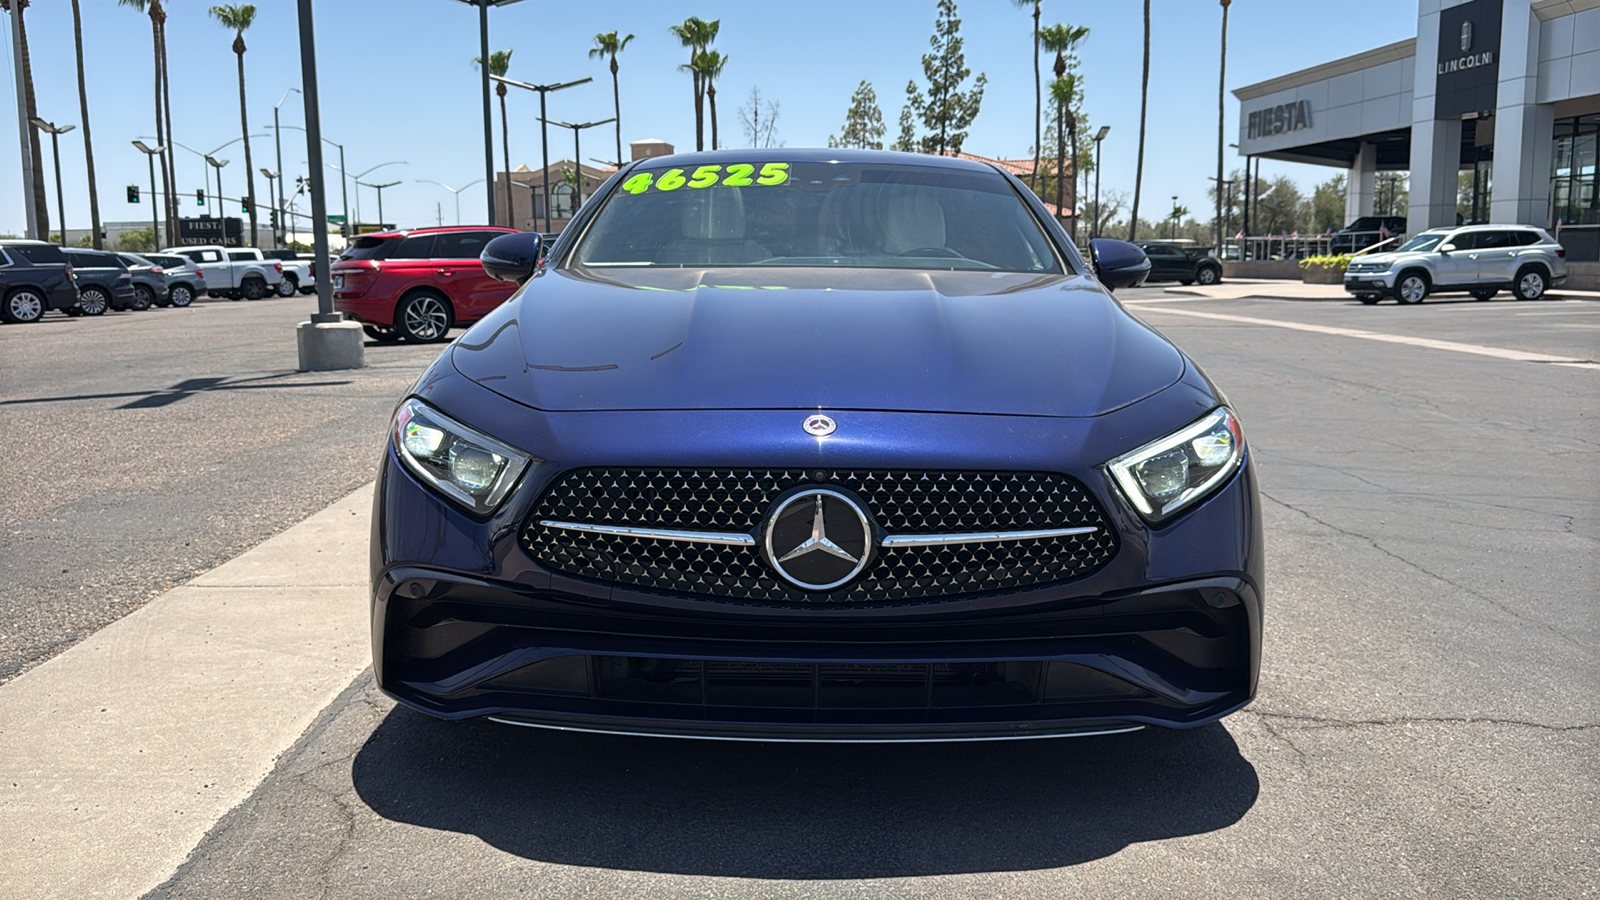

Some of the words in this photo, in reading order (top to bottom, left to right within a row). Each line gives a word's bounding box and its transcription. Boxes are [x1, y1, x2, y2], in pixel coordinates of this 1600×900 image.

[1438, 52, 1492, 75] LINCOLN
[1247, 100, 1312, 139] FIESTA
[622, 162, 790, 195] 46525
[181, 237, 207, 245] USED
[209, 237, 237, 245] CARS
